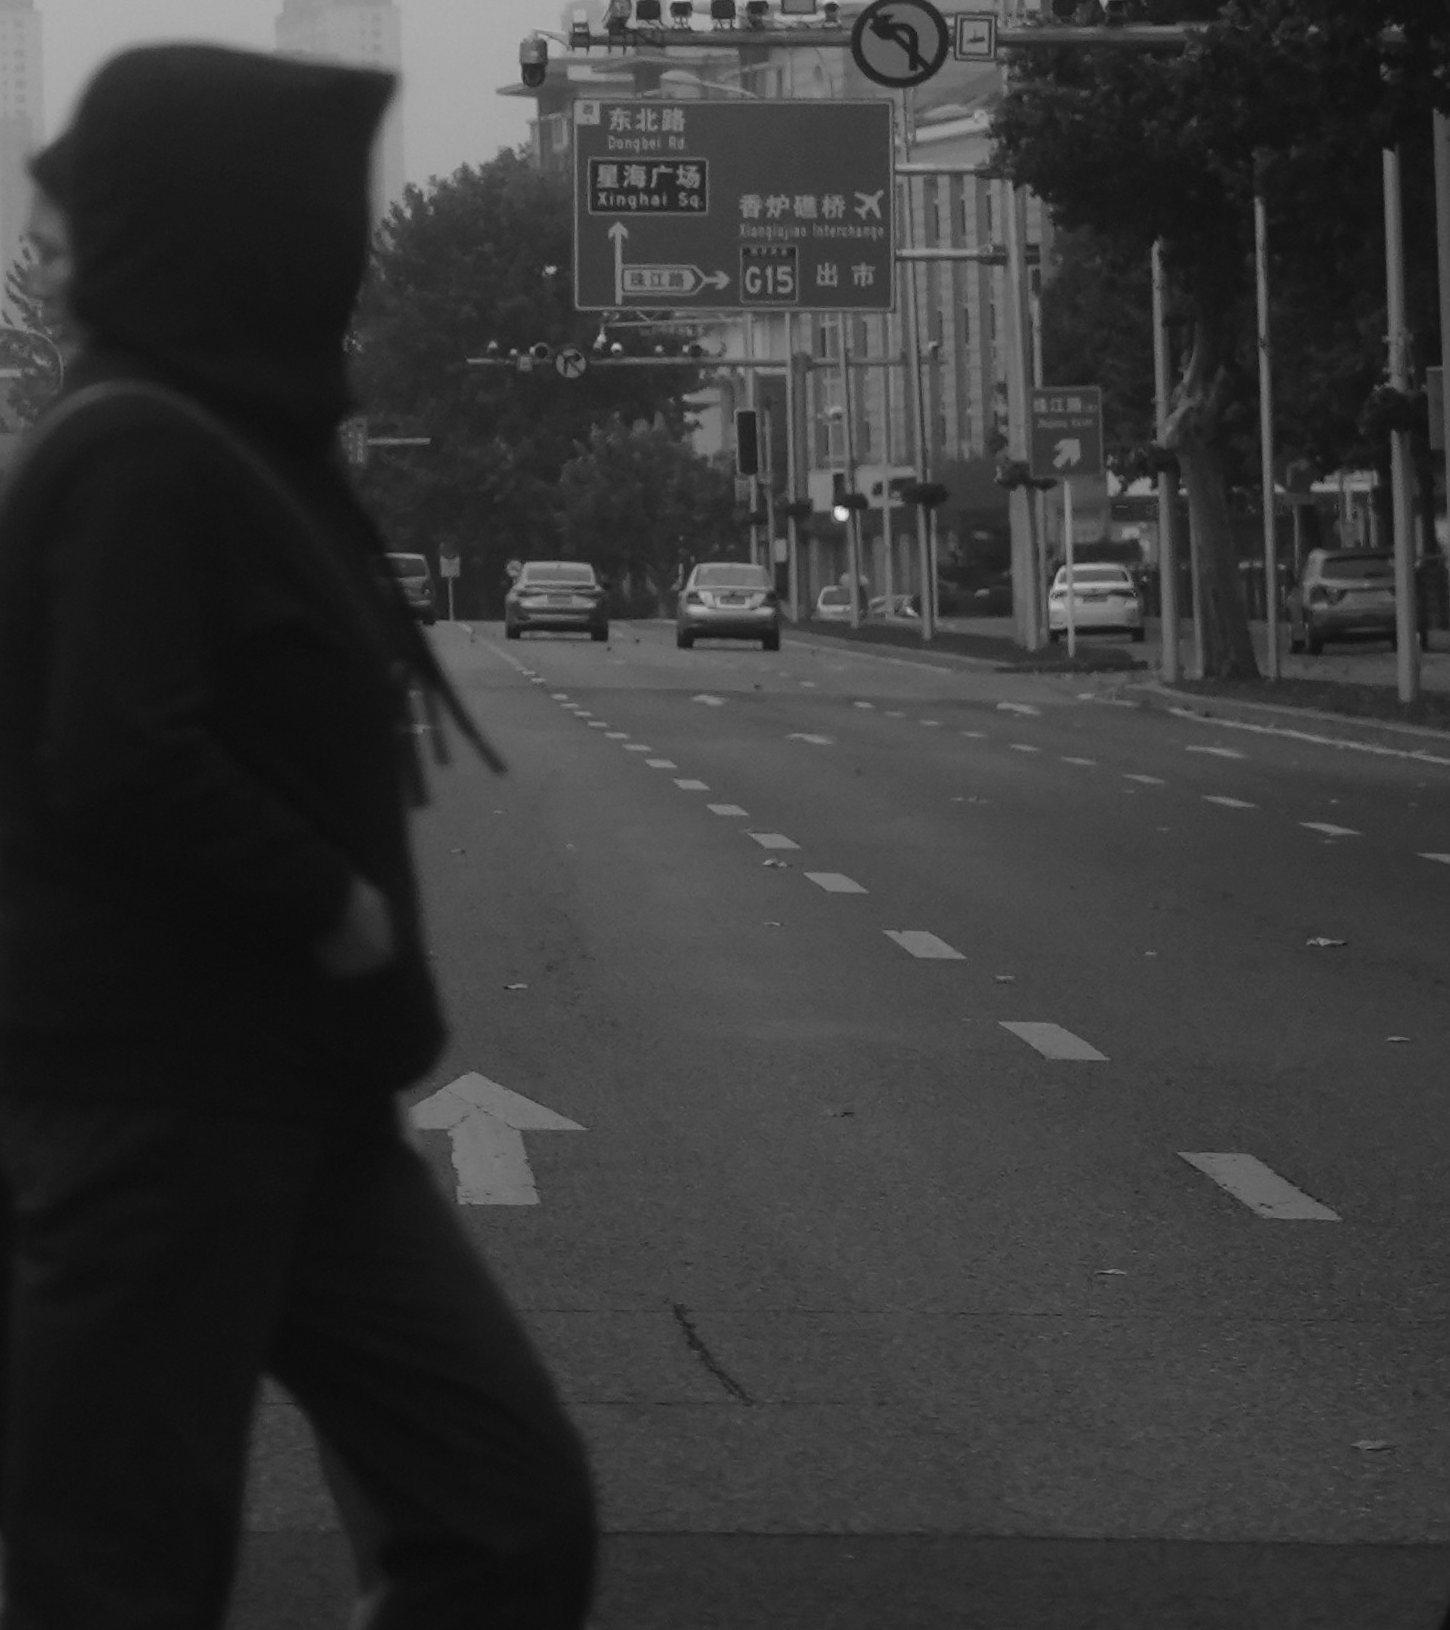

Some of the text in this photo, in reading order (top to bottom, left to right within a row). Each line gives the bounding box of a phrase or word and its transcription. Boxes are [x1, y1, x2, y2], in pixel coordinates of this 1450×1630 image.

[608, 107, 685, 132] 东北路
[596, 164, 702, 189] 星海广场
[597, 191, 668, 209] Xinghai
[744, 264, 794, 295] G15
